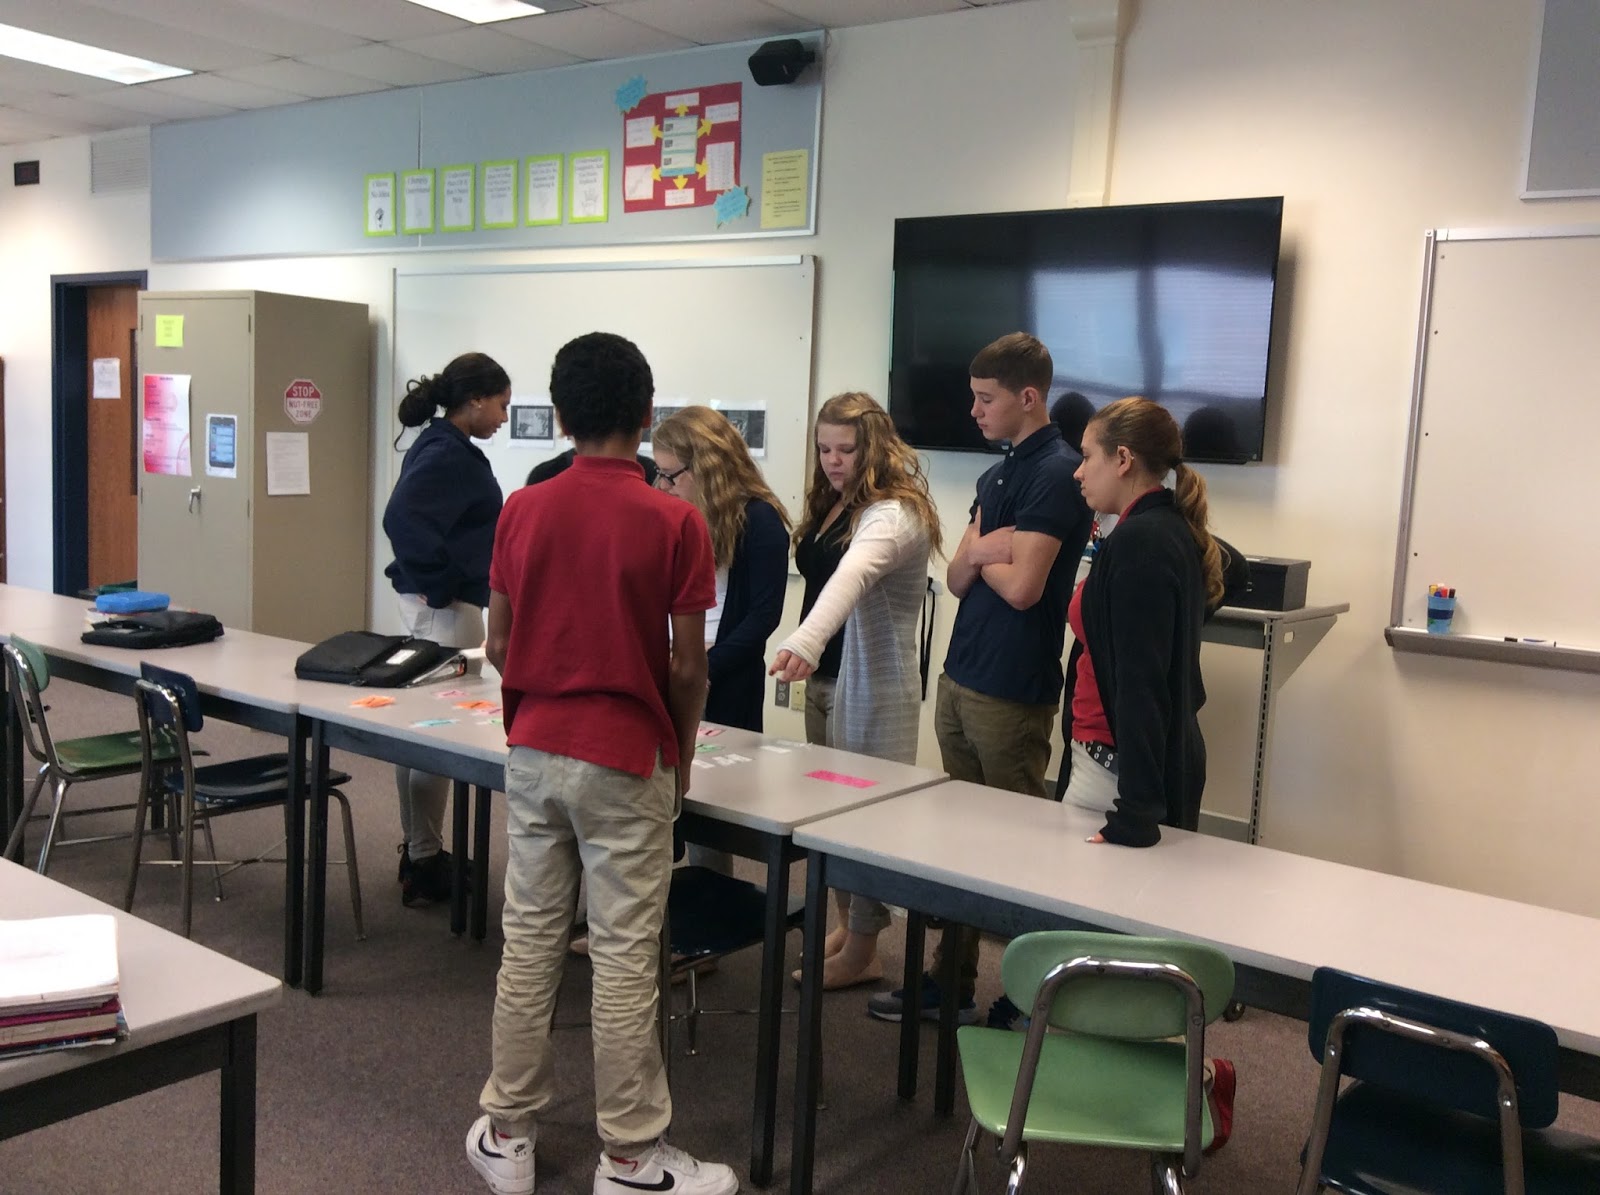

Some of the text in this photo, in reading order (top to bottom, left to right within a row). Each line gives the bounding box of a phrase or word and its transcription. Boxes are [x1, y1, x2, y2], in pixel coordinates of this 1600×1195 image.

[292, 385, 315, 397] STOP
[288, 400, 318, 408] NUT-FREE
[295, 410, 312, 418] ZONE
